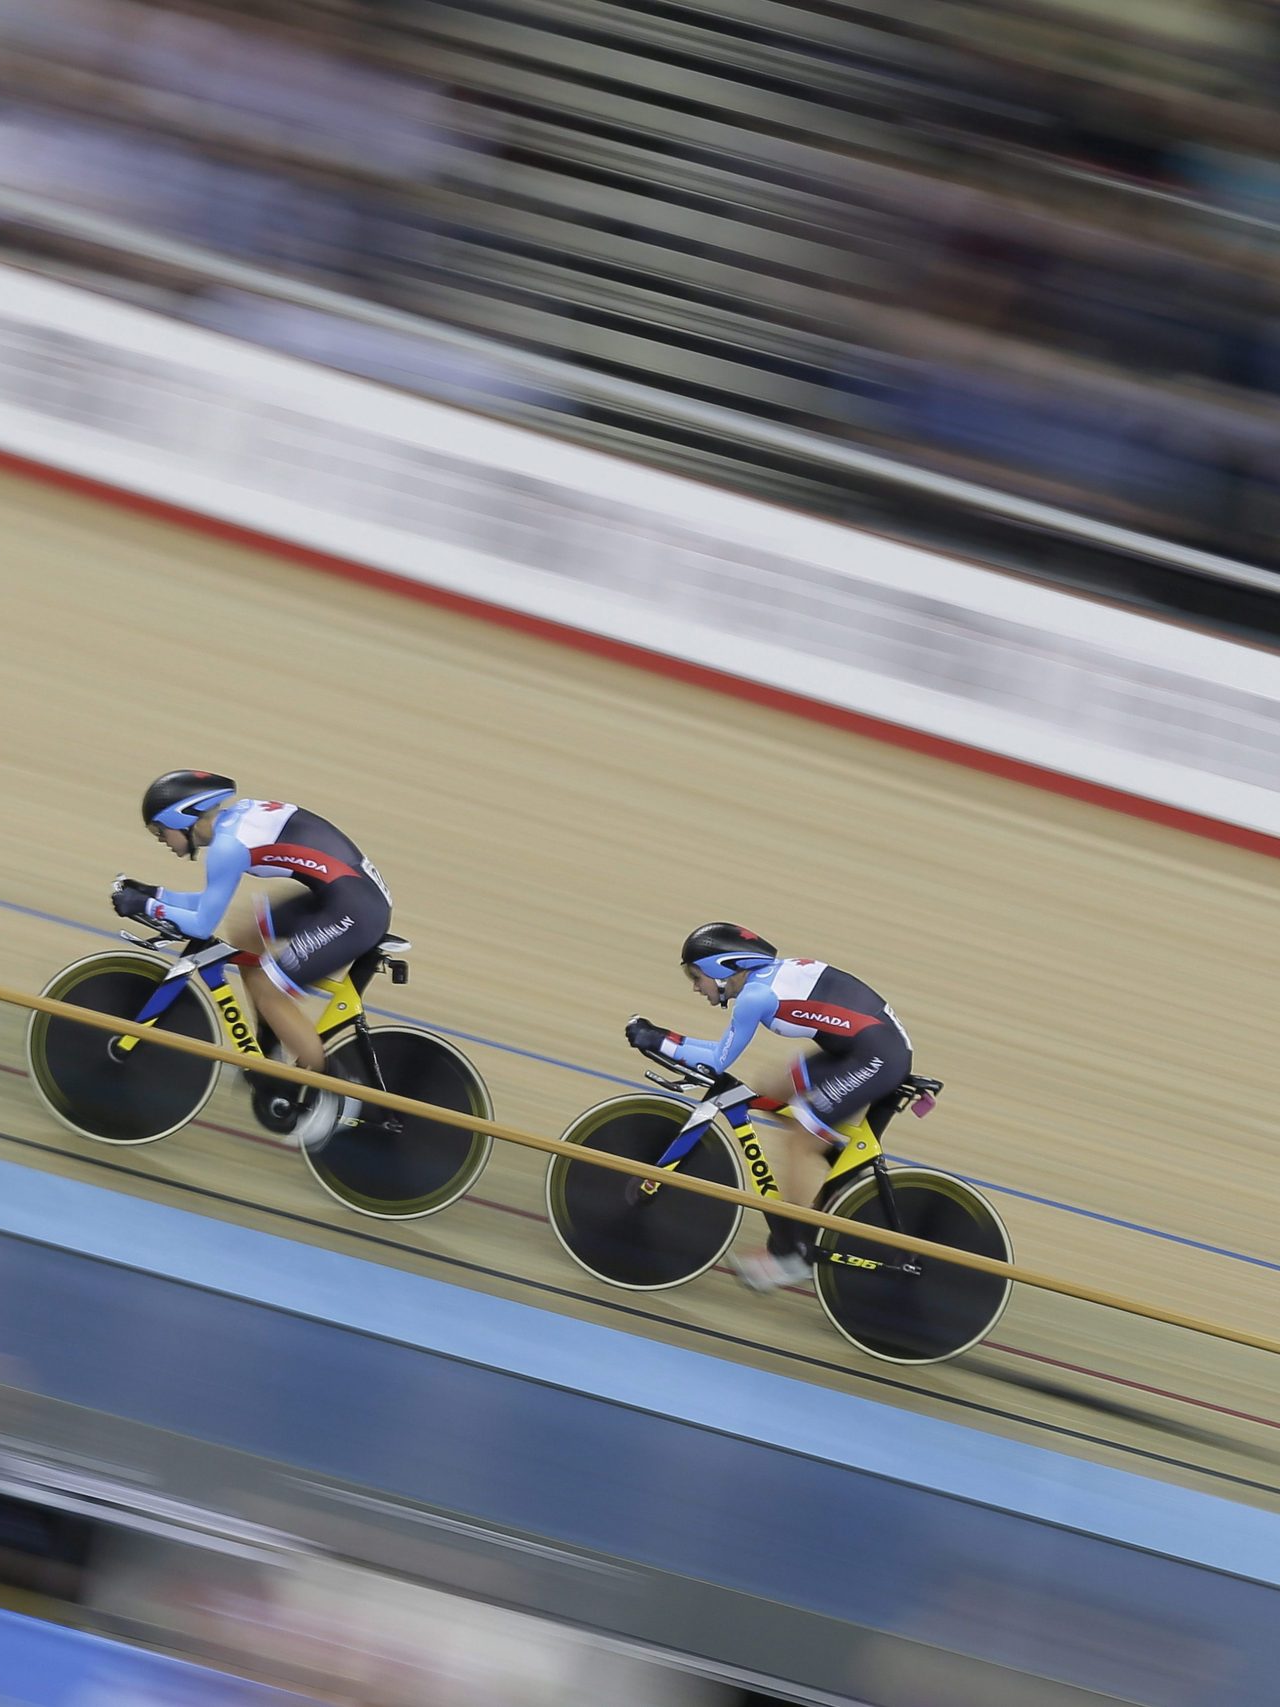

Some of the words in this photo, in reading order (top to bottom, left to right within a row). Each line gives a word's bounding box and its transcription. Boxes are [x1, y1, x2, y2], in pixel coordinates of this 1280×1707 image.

[262, 855, 328, 874] CANADA
[217, 995, 260, 1054] LOOK
[791, 1010, 851, 1029] CANADA
[738, 1132, 780, 1196] LOOK
[830, 1253, 878, 1270] L96
